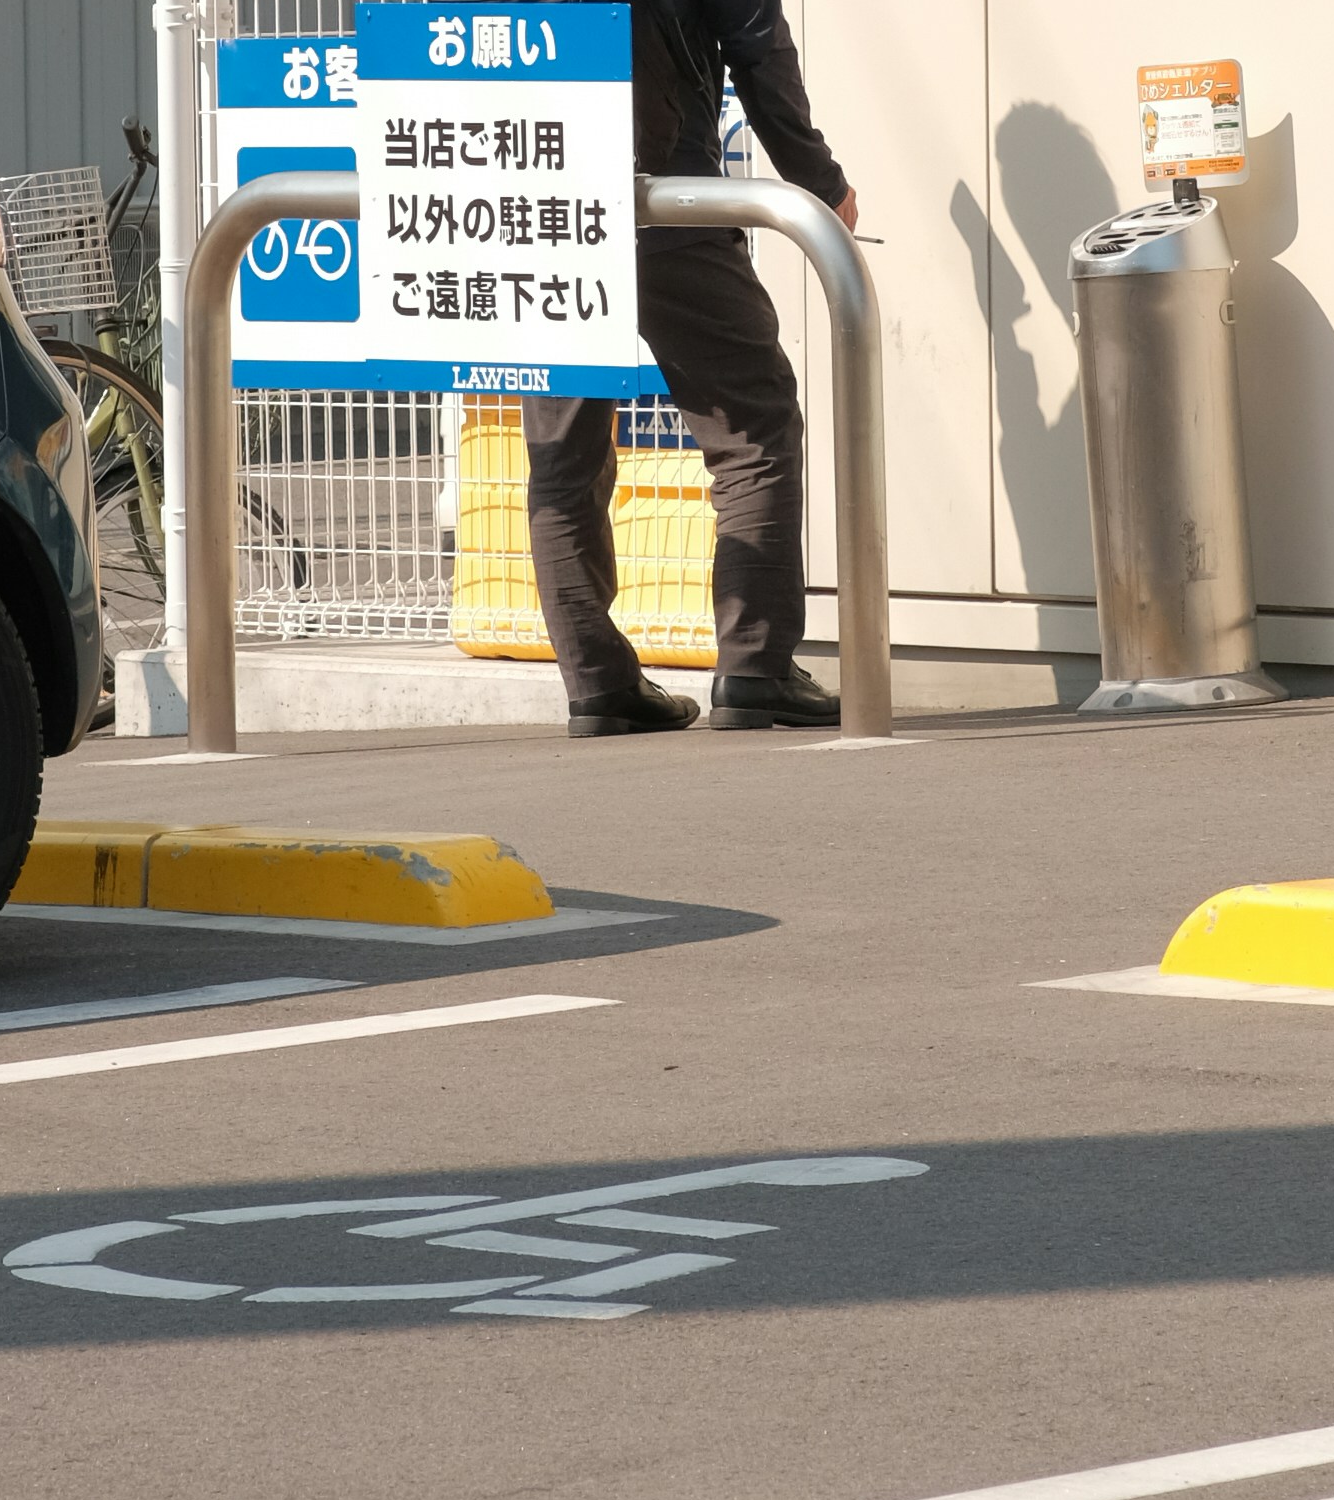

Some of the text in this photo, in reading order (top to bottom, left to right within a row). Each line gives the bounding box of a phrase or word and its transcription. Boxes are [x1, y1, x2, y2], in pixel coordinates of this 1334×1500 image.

[427, 14, 557, 70] お願い
[1140, 79, 1233, 101] ひめシェルター
[384, 118, 566, 171] 当店ご利用
[386, 193, 608, 248] 以外の駐車は
[391, 270, 609, 323] ご遠慮下さい
[451, 365, 551, 392] LAWSON
